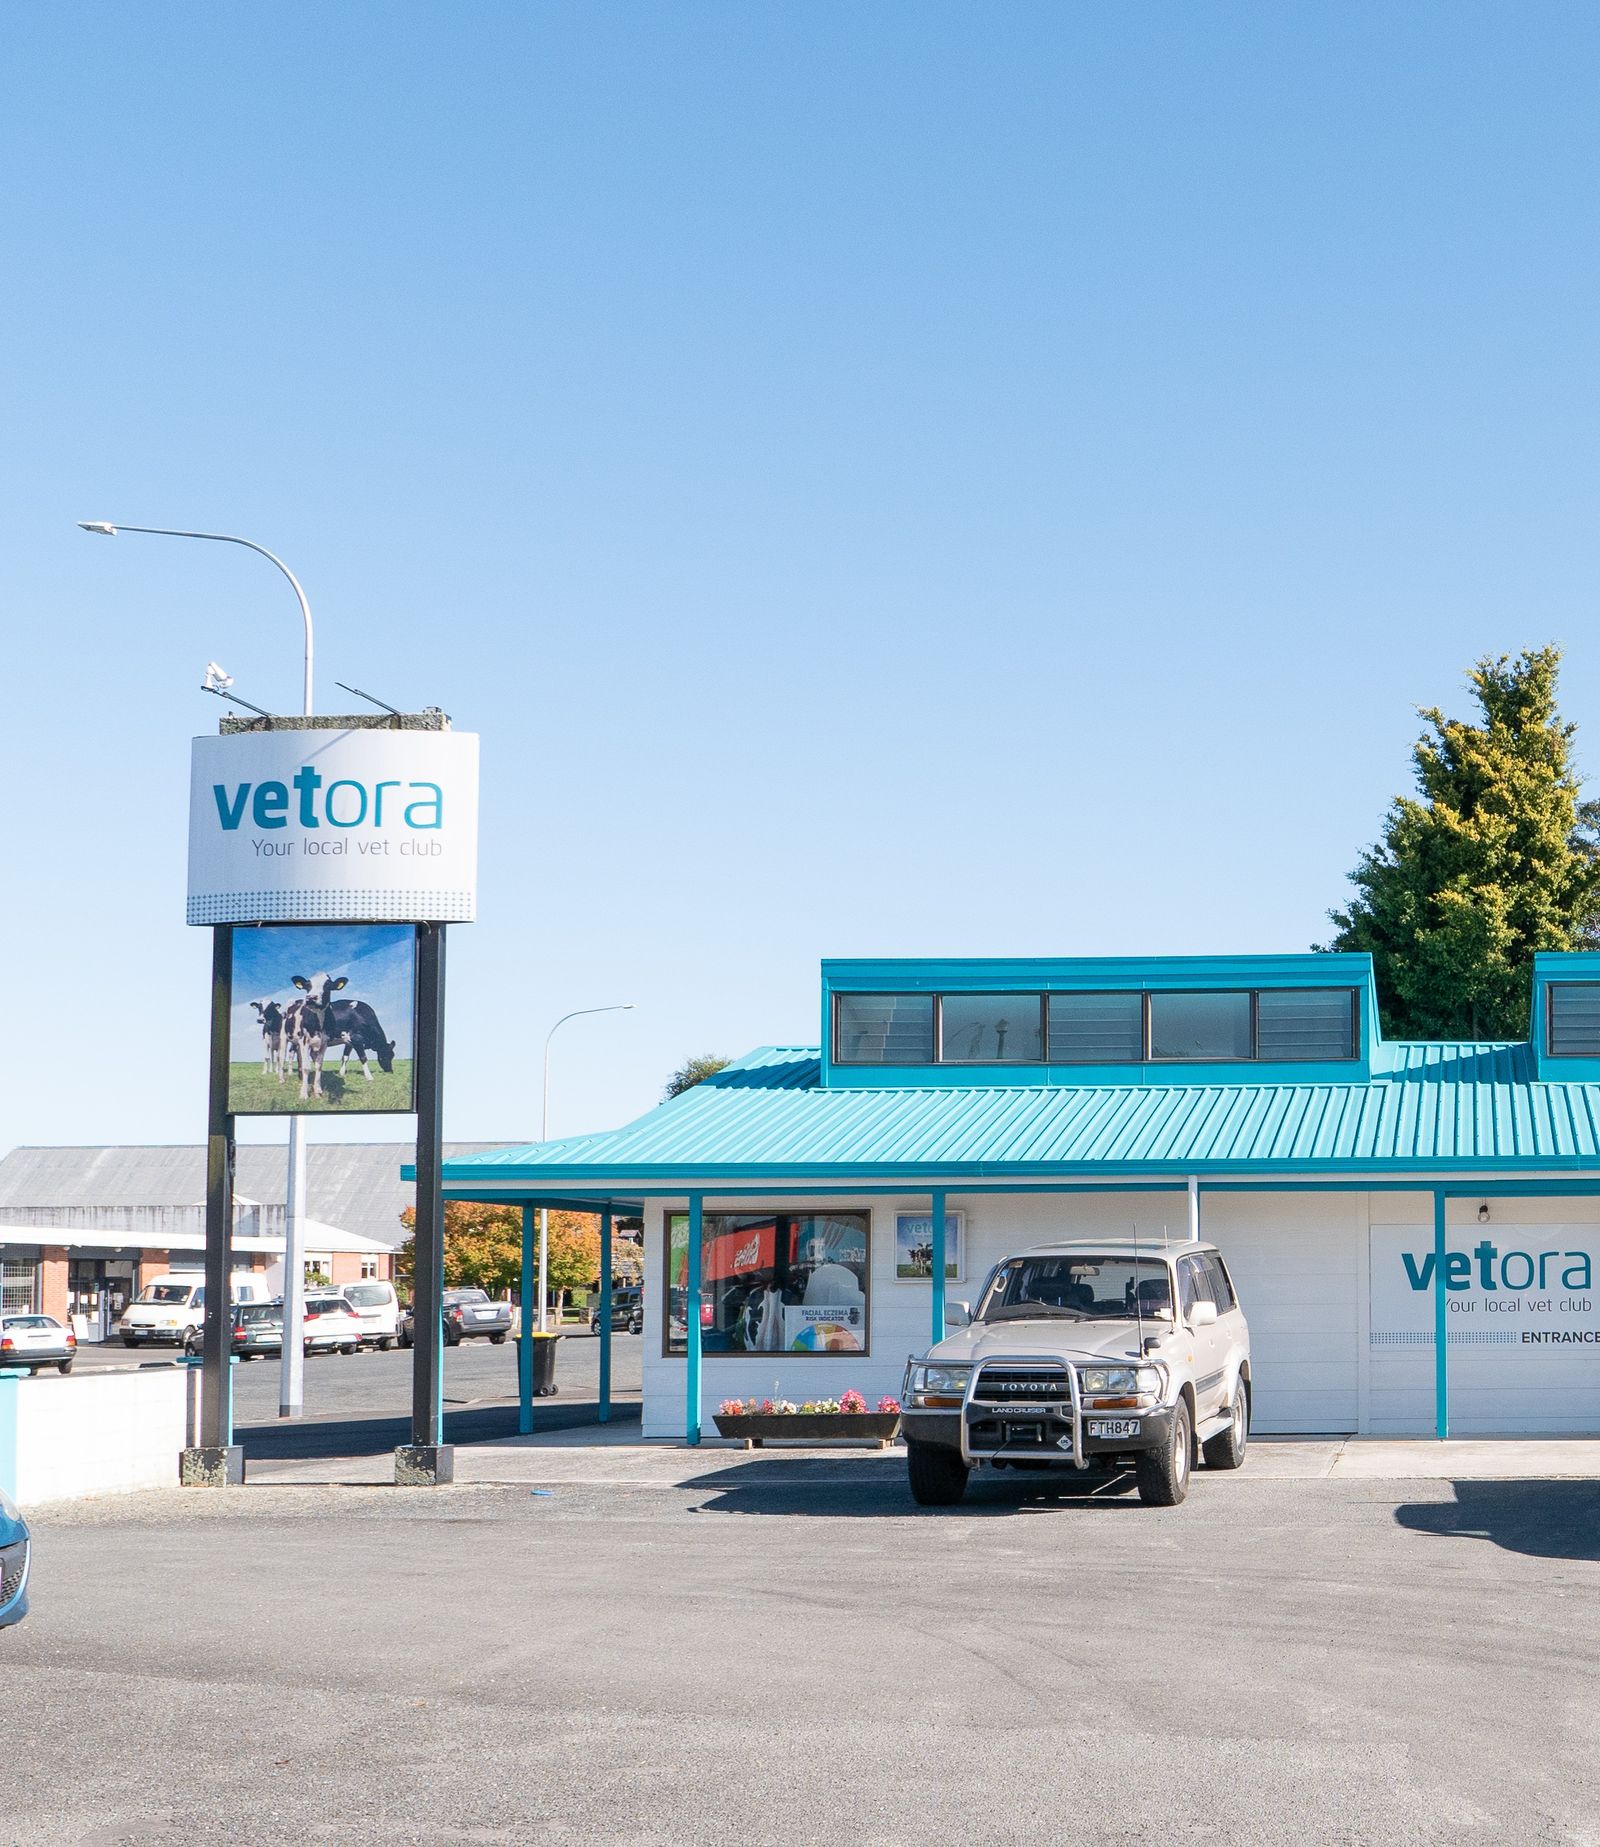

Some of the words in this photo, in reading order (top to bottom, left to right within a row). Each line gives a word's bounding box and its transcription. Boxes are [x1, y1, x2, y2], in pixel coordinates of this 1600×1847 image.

[213, 766, 443, 831] vetora
[252, 839, 294, 857] Your
[303, 838, 348, 856] local
[358, 839, 390, 856] vet
[399, 839, 442, 857] club
[1401, 1240, 1592, 1291] vetora
[1484, 1298, 1521, 1312] local
[1528, 1299, 1552, 1312] vet
[1559, 1297, 1592, 1312] club
[1000, 1383, 1058, 1392] TOYOTA
[1089, 1420, 1140, 1434] FTH847
